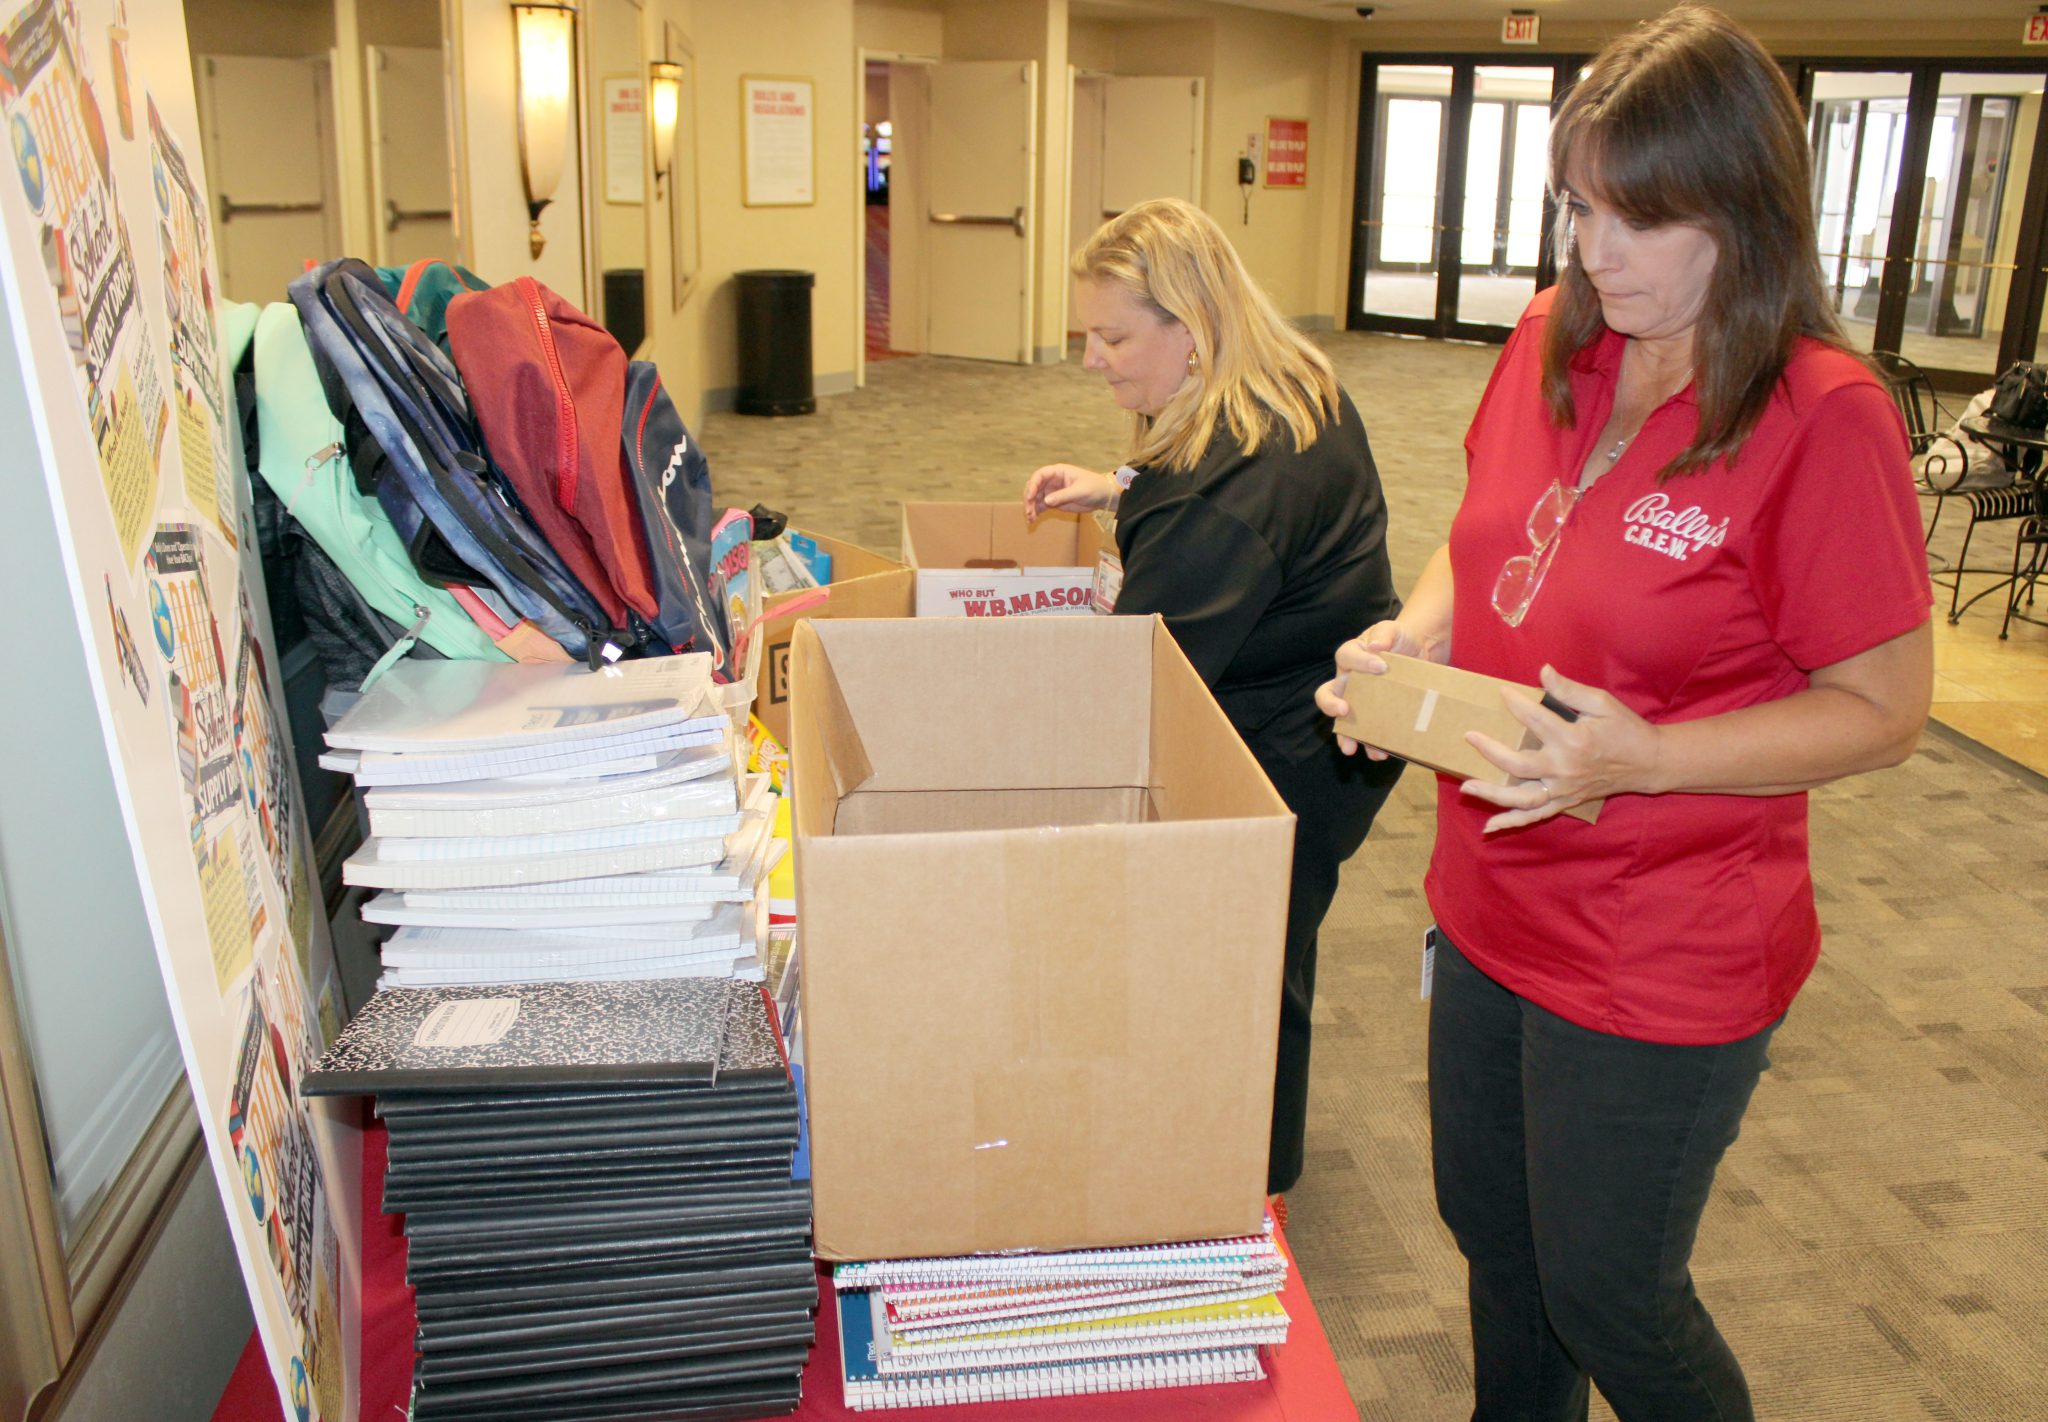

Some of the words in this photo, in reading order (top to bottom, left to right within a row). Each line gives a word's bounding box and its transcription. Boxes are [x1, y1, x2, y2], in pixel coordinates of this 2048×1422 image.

[1506, 16, 1537, 40] EXIT
[2029, 16, 2048, 41] EX
[89, 296, 115, 380] SUPPLY
[1623, 493, 1731, 552] Bally's
[949, 589, 973, 599] WHO
[975, 589, 996, 598] BUT
[198, 766, 228, 816] SUPPLY
